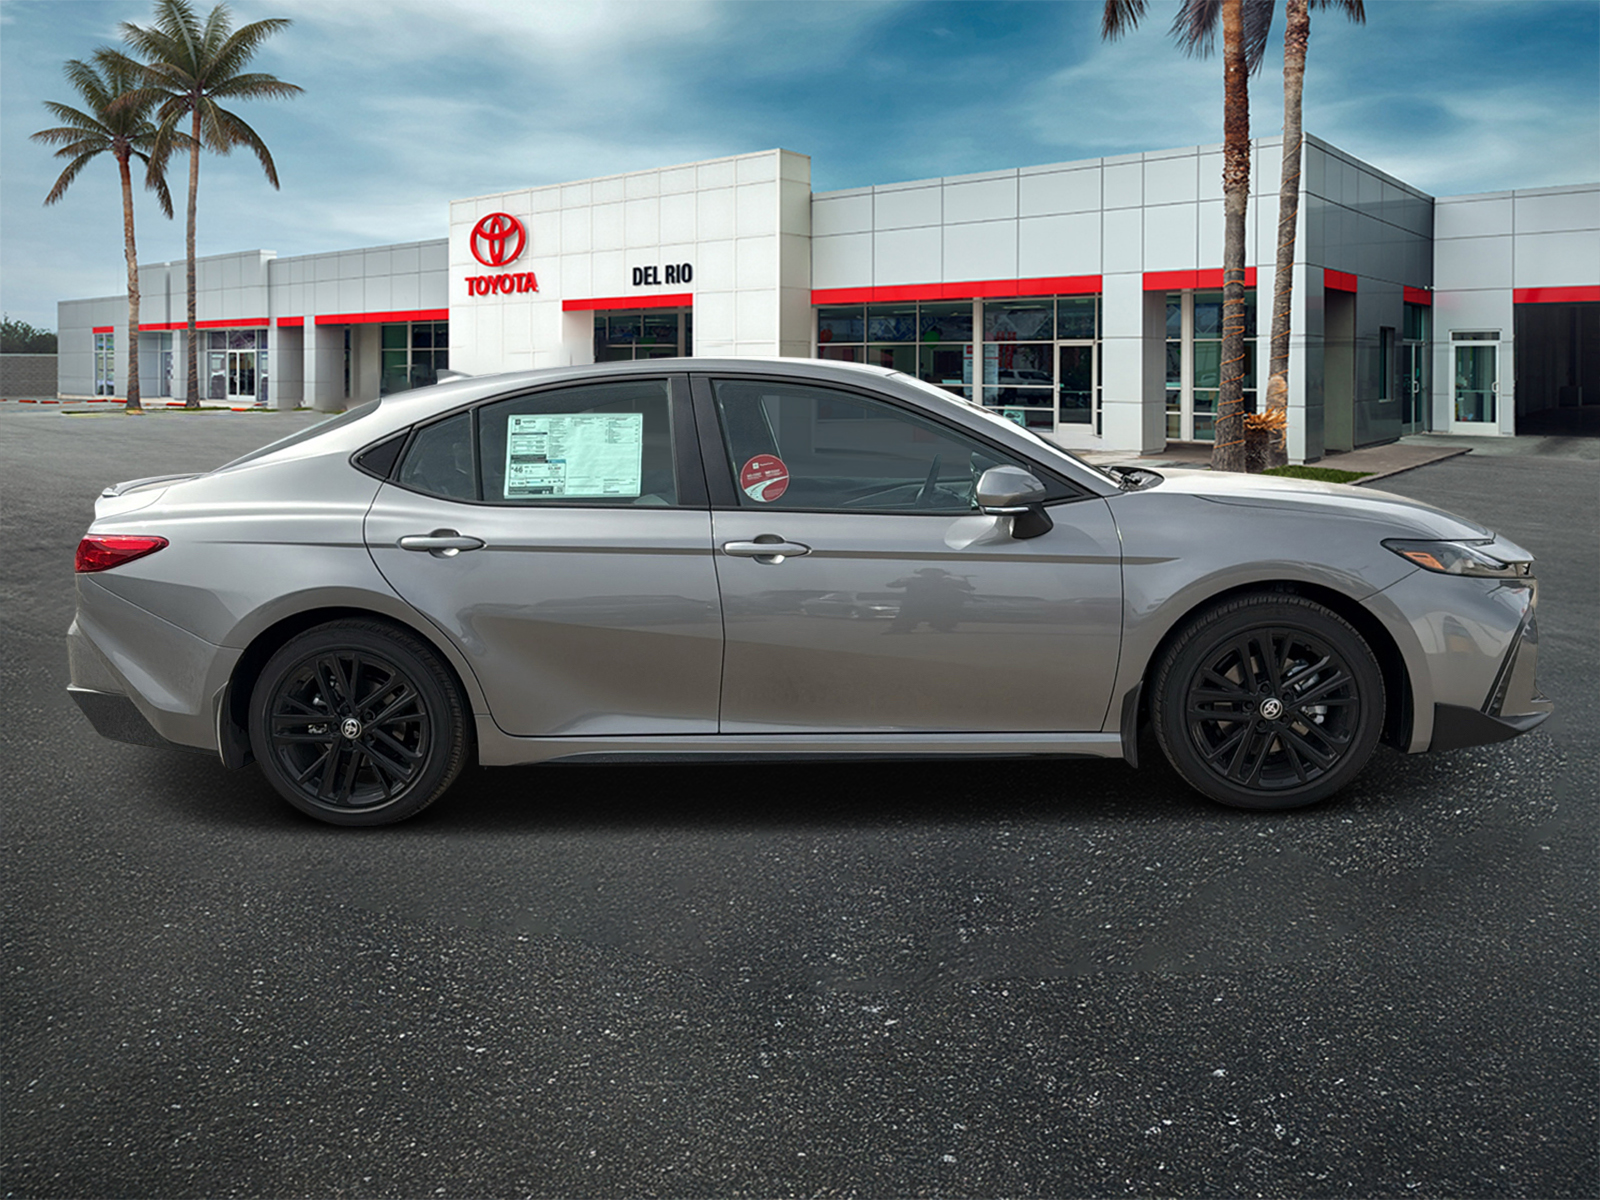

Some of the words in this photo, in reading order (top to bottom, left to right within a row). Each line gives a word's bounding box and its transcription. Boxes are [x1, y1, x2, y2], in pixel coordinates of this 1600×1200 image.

[465, 272, 539, 297] TOYOTA
[633, 266, 661, 286] DEL
[665, 263, 693, 284] RIO
